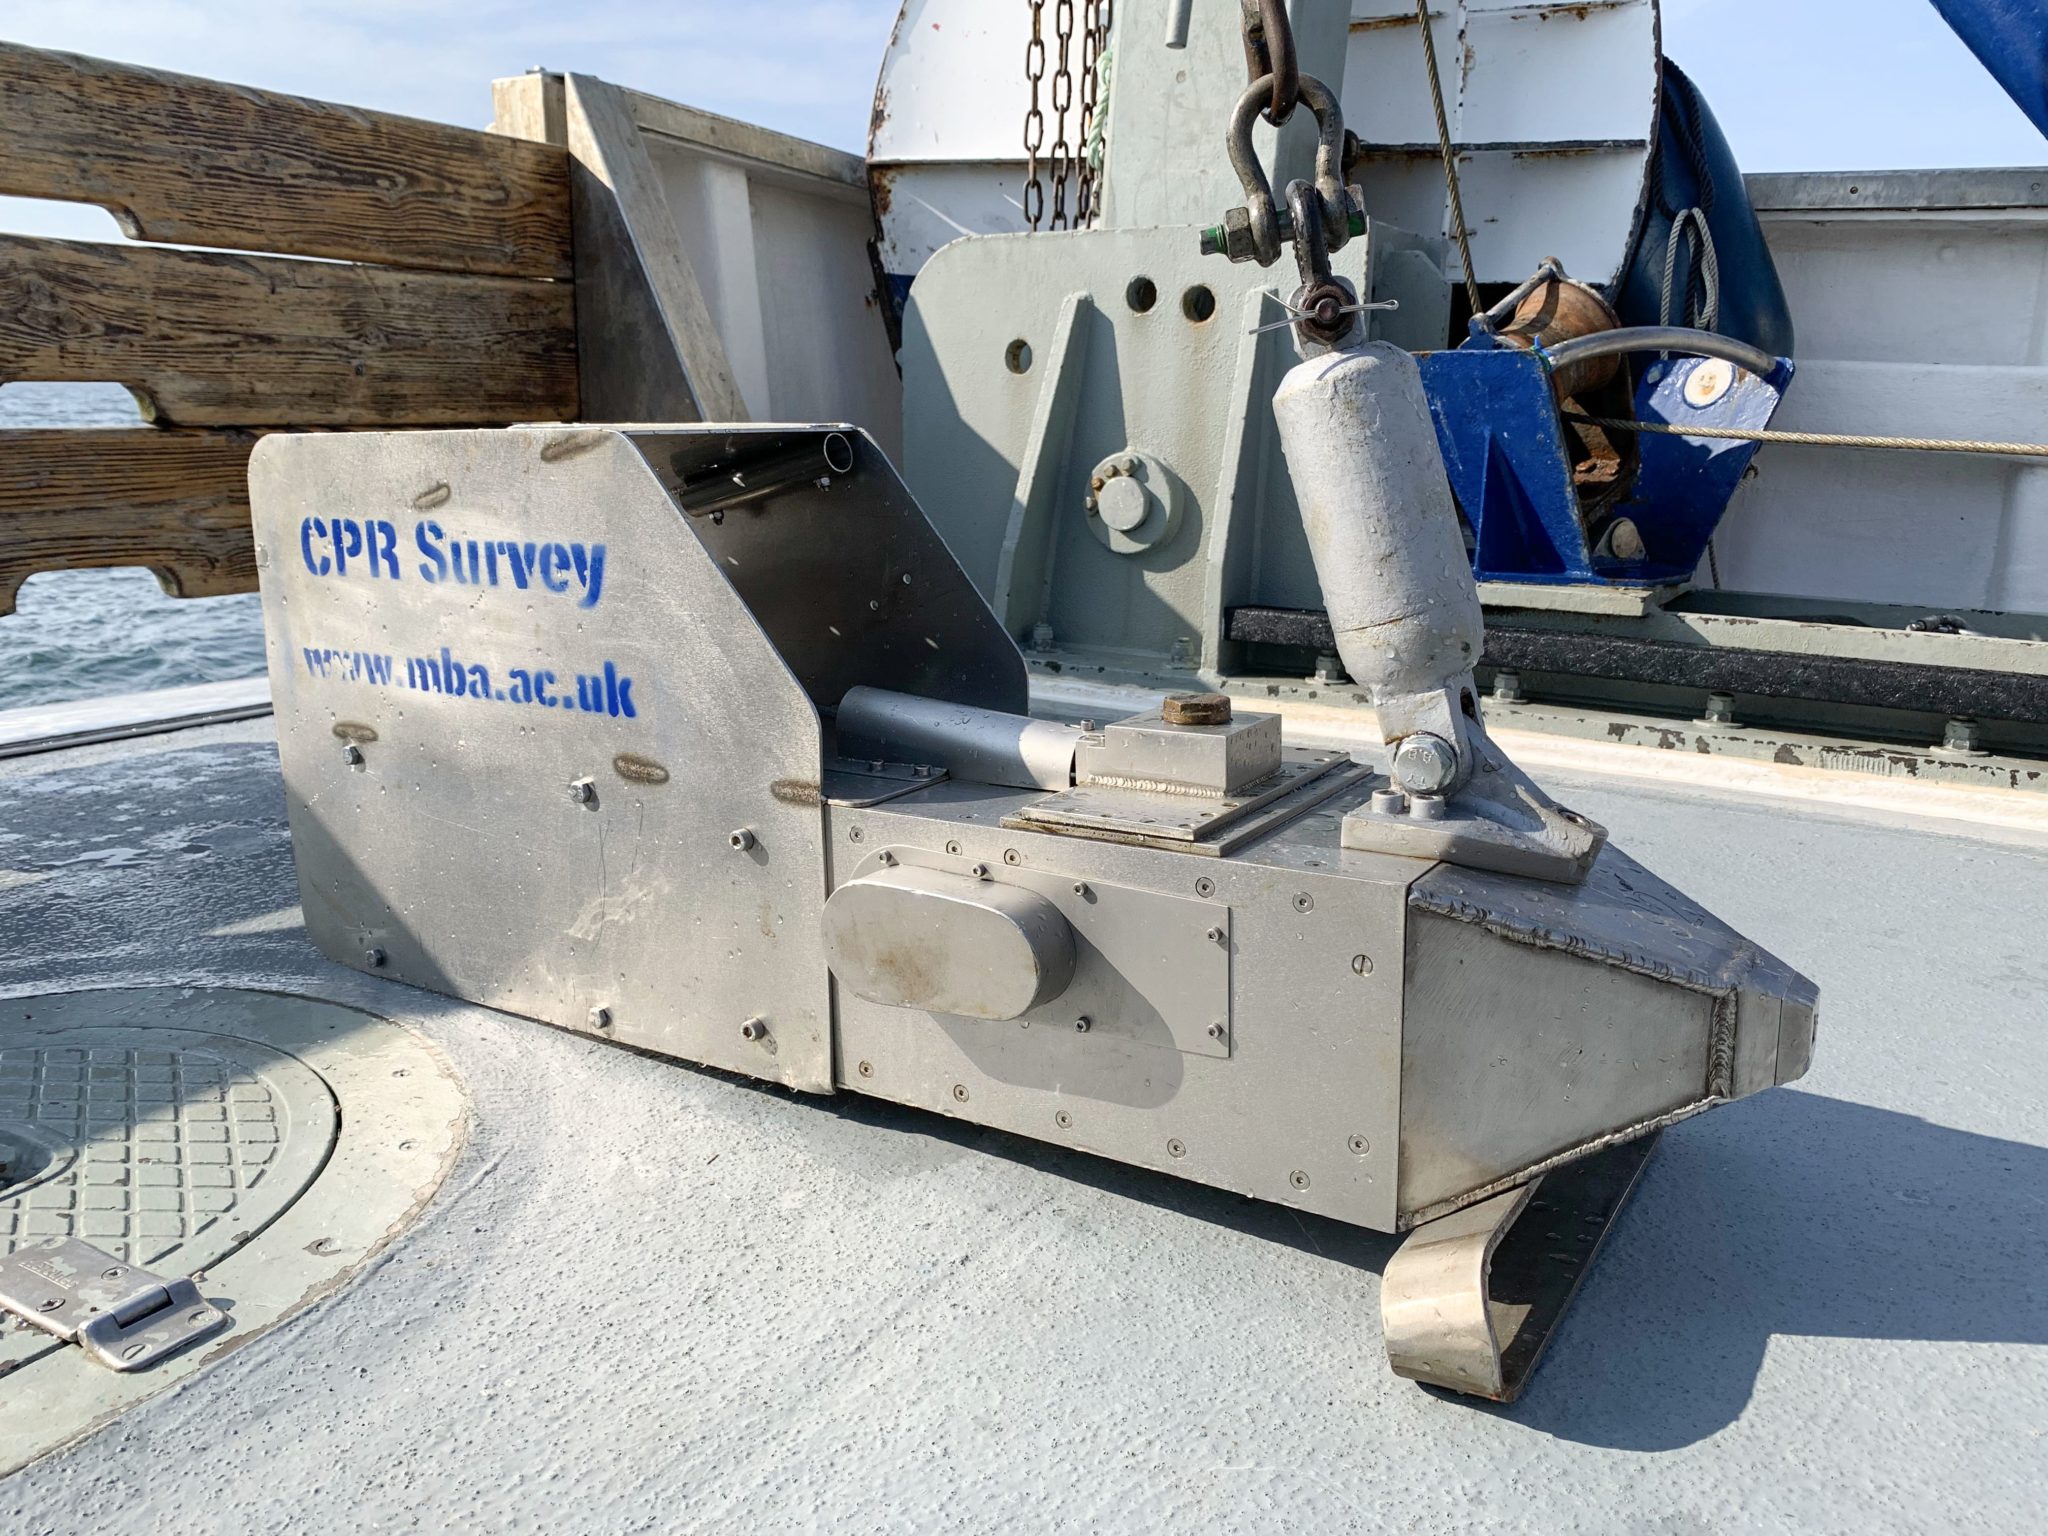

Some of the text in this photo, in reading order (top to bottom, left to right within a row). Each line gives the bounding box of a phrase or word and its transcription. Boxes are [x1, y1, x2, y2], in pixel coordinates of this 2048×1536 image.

[300, 515, 607, 609] CPR Survey
[302, 646, 637, 719] www.mba.ac.uk
